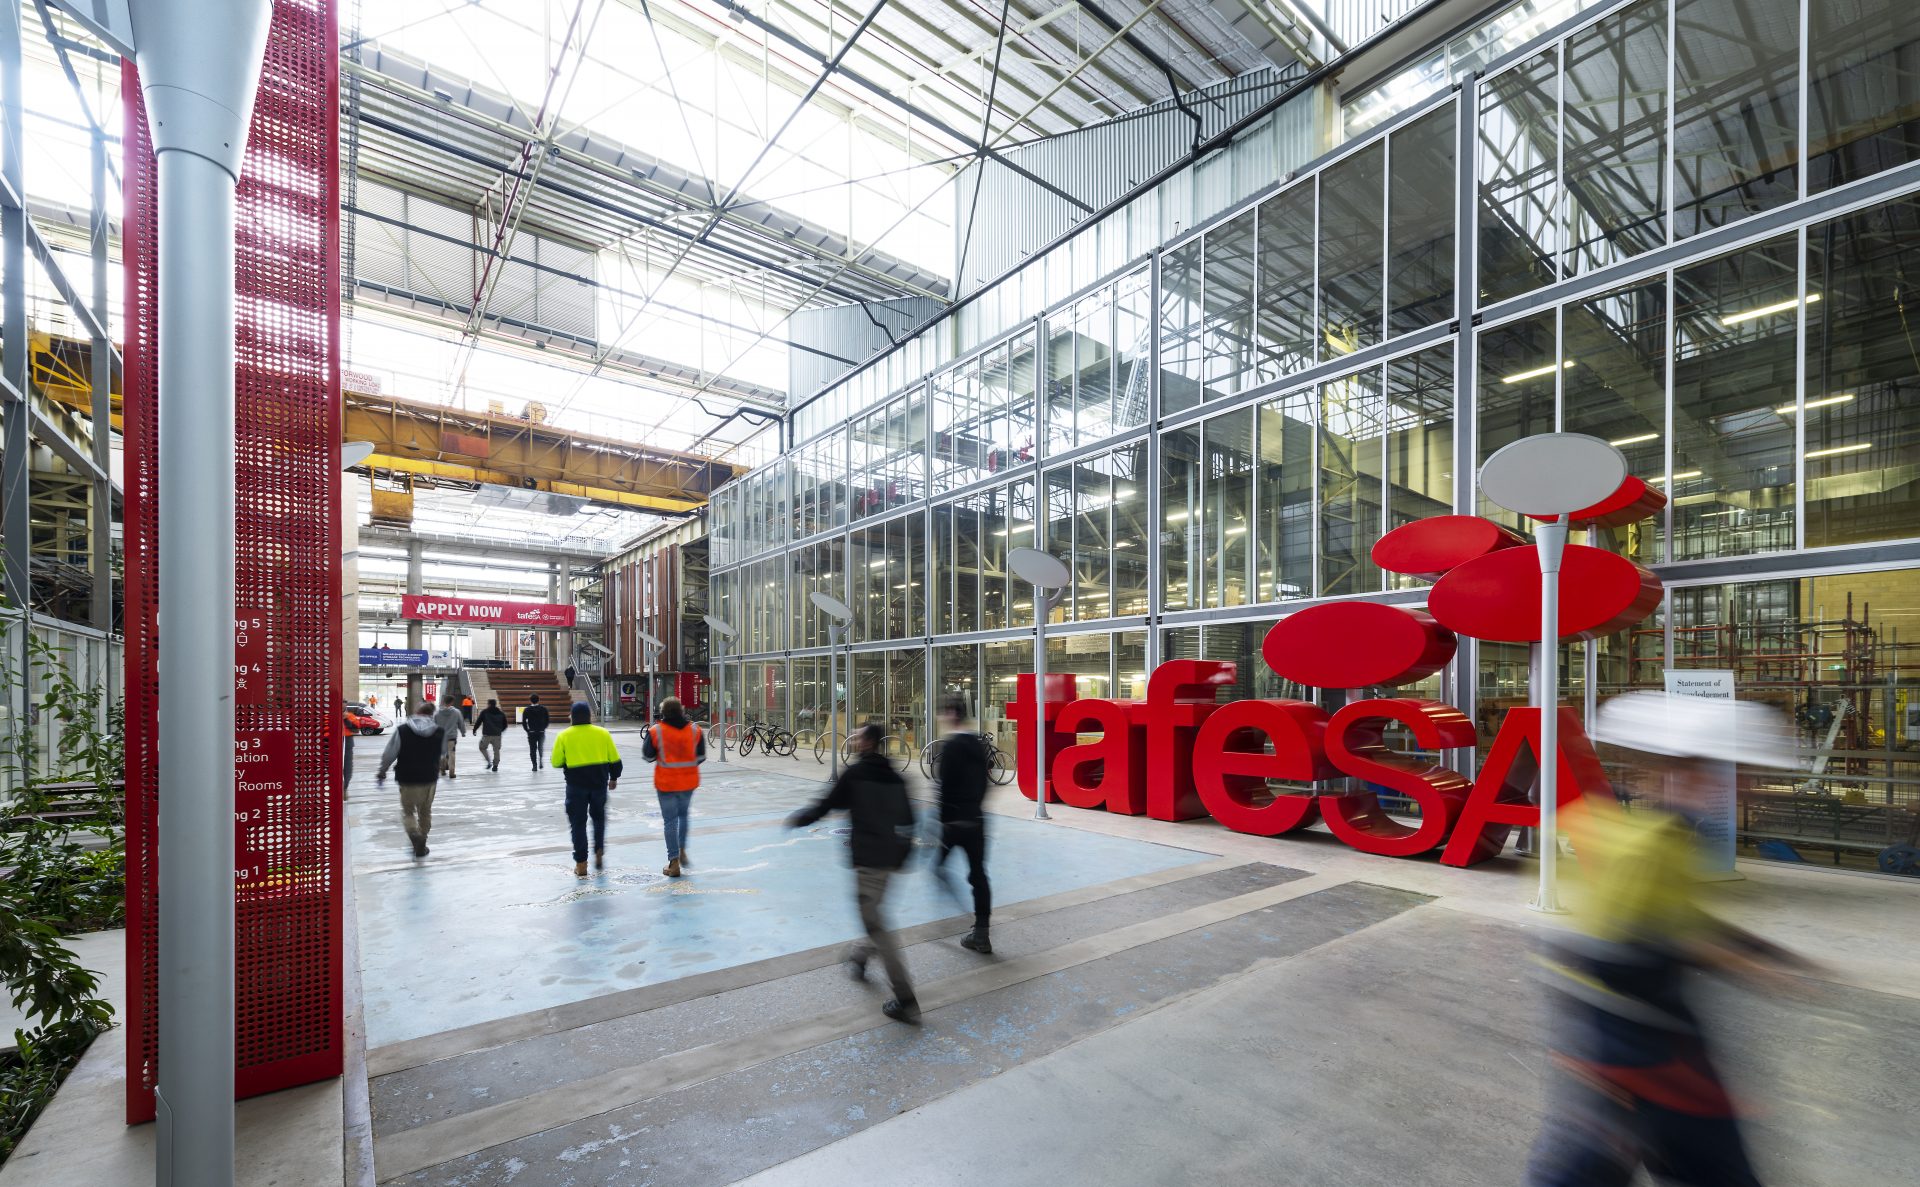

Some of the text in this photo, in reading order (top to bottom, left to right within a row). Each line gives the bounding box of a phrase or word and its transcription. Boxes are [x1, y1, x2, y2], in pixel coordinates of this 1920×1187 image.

[416, 602, 503, 618] APPLY NOW
[517, 612, 541, 620] tafeSA
[252, 618, 260, 628] 5
[252, 662, 261, 672] 4
[1677, 679, 1722, 687] Statement of
[252, 738, 261, 748] 3
[1006, 660, 1610, 869] tafeSA
[239, 781, 283, 791] Rooms
[252, 808, 261, 819] 2
[253, 865, 259, 875] 1
